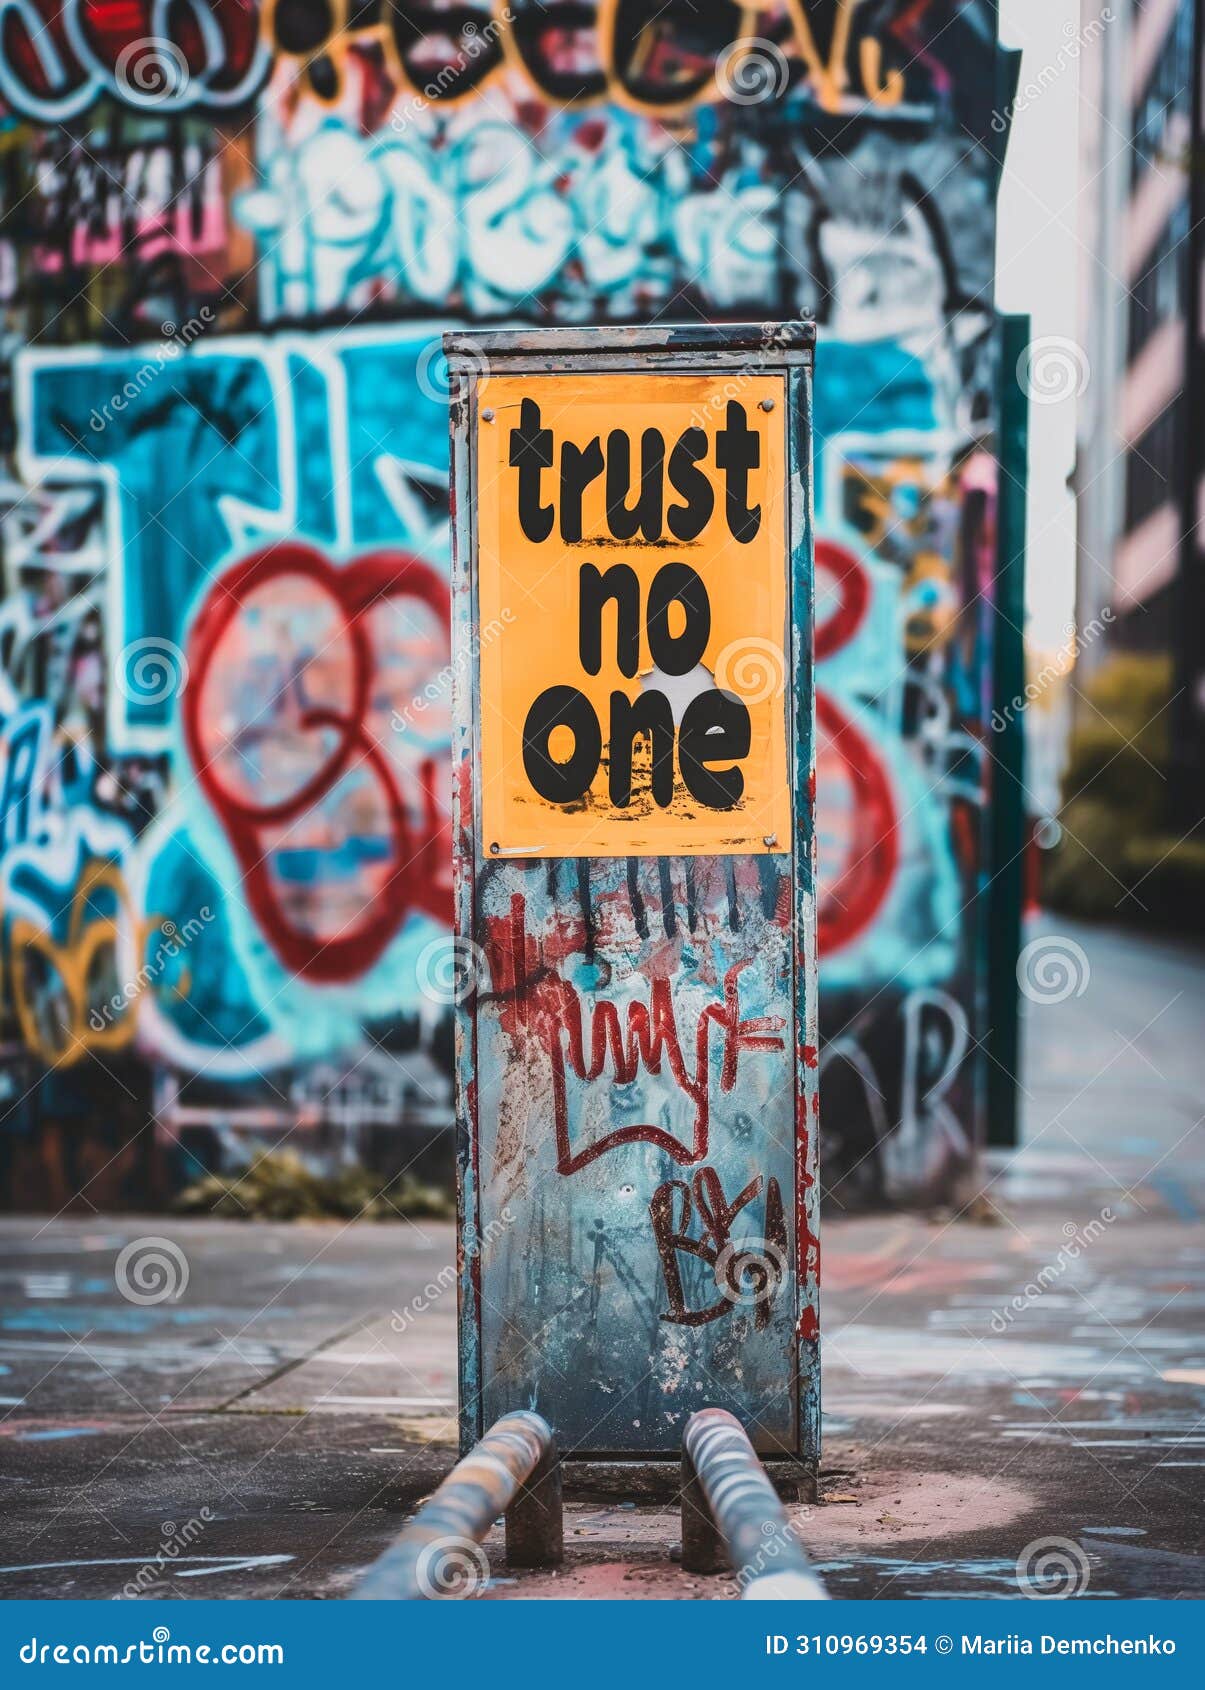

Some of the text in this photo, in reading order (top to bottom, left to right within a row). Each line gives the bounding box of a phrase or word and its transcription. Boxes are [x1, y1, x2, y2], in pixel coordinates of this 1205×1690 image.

[509, 397, 761, 544] trust
[579, 562, 711, 679] no
[522, 685, 752, 810] one
